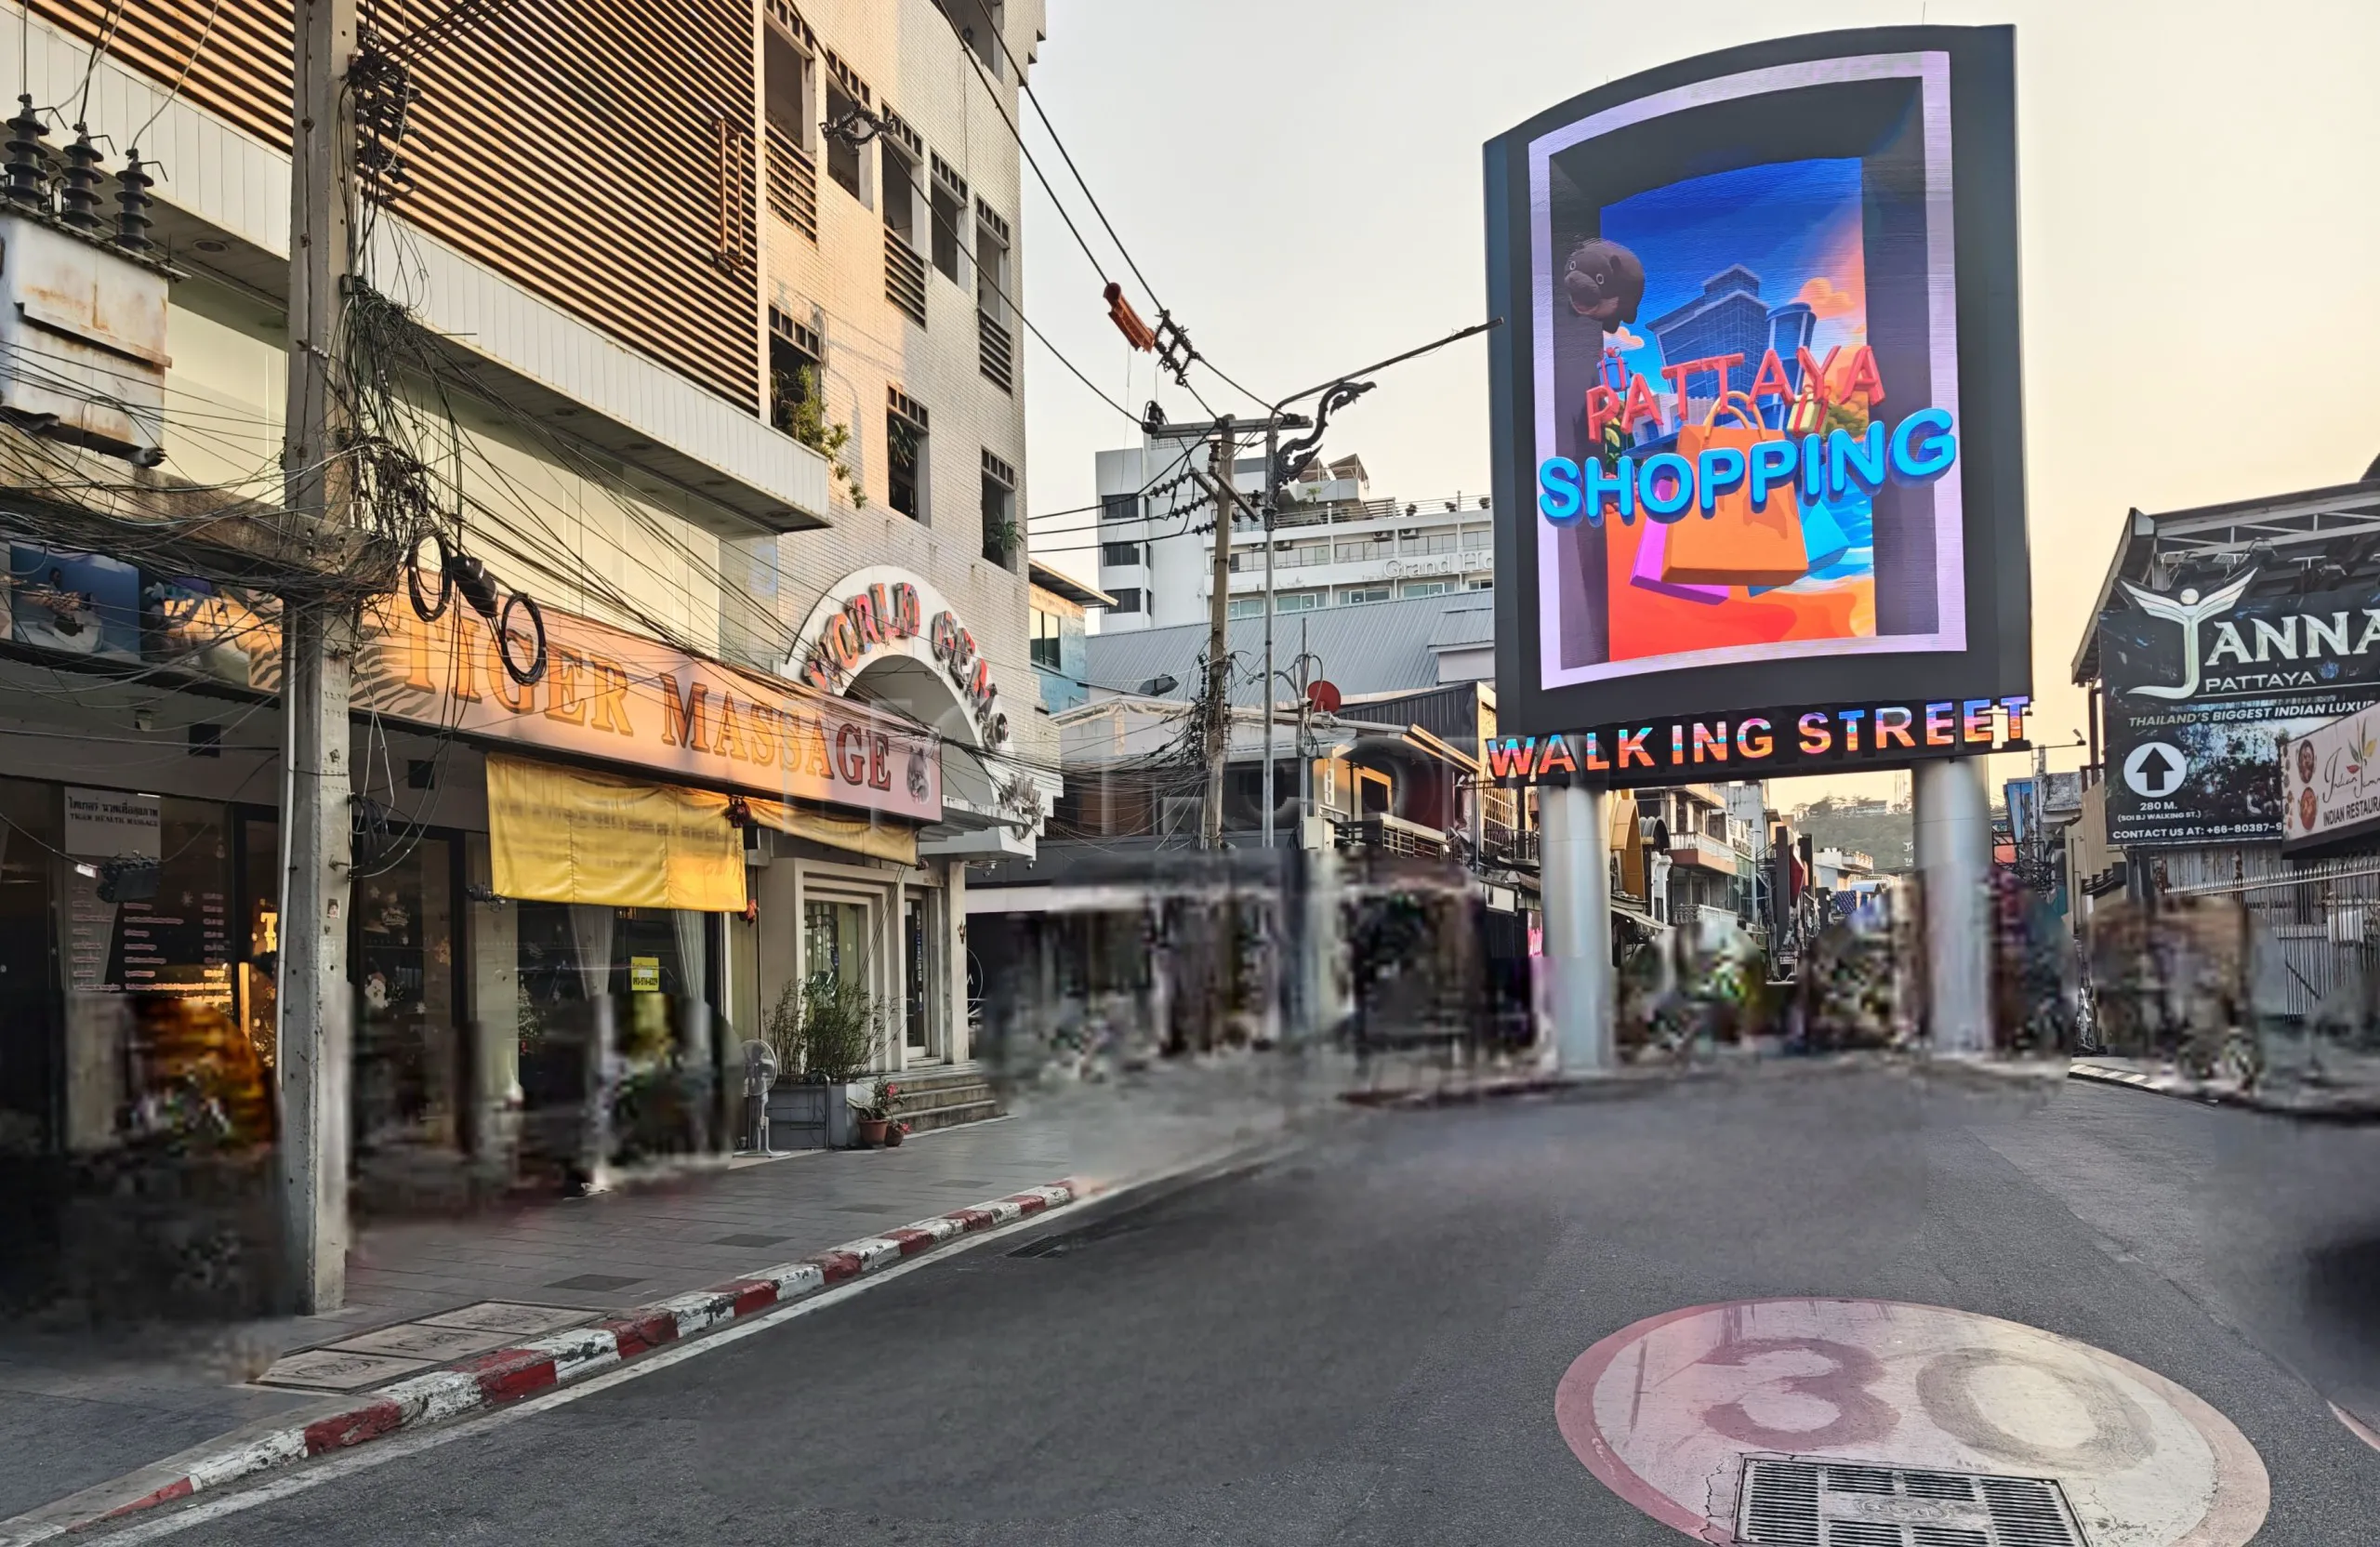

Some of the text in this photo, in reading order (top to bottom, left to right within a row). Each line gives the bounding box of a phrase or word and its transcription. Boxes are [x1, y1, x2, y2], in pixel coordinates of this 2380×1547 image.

[1585, 345, 1885, 443] PATTAYA
[1539, 408, 1957, 527] SHOPPING
[1383, 554, 1452, 578] Grand
[2205, 670, 2316, 692] PATTAYA
[396, 602, 891, 791] TIGER MASSAGE
[2213, 707, 2271, 721] BIGGEST
[2275, 704, 2326, 717] INDIAN
[1798, 696, 2030, 755] STREET
[2140, 802, 2162, 812] 280
[2147, 812, 2185, 820] WALKING
[2323, 805, 2345, 826] INDIAN
[2112, 828, 2169, 839] CONTACT
[2170, 827, 2184, 837] US
[1696, 1335, 2157, 1474] 30
